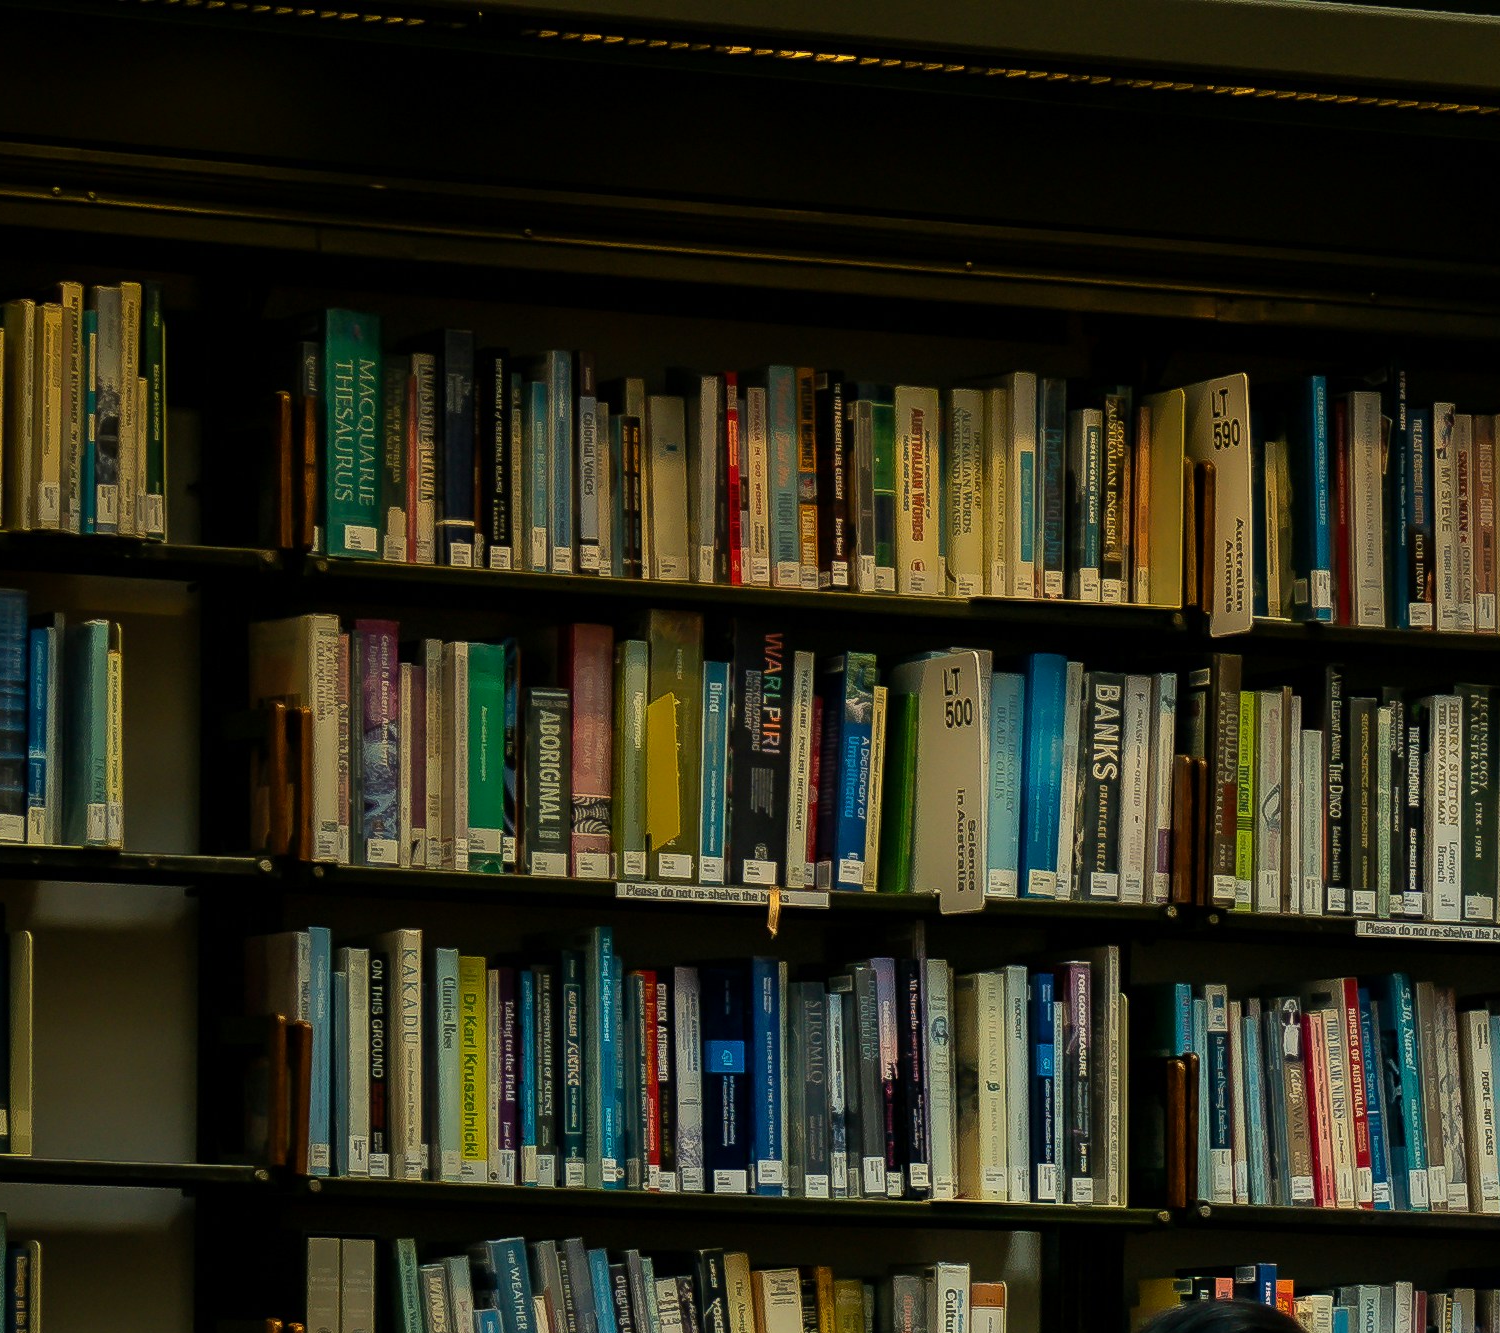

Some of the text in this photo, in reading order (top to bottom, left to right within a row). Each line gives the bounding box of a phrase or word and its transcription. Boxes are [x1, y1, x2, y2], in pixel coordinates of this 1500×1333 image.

[335, 360, 353, 501] THESAURUS
[357, 359, 374, 507] MACQUARIE
[1212, 390, 1229, 416] LT
[1214, 420, 1241, 450] 590
[583, 412, 595, 495] Colonial Voices
[911, 408, 924, 541] AUSTRALIAN WORDS
[1235, 518, 1245, 612] Australian
[762, 633, 784, 755] WARLPIRI
[944, 668, 961, 696] LT
[944, 698, 973, 728] 500
[538, 710, 560, 824] ABORIGINAL
[1092, 683, 1118, 780] BANKS
[1448, 703, 1459, 827] HENRY SUTTON
[956, 810, 967, 892] Australia
[967, 819, 977, 890] Science
[1366, 922, 1396, 934] Please
[371, 960, 384, 1078] ON THIS GROUND
[401, 948, 418, 1044] KAKADU
[462, 993, 479, 1157] Dr Karl Kruszelnicki
[509, 1267, 527, 1330] WEATHER
[615, 1275, 632, 1326] digging
